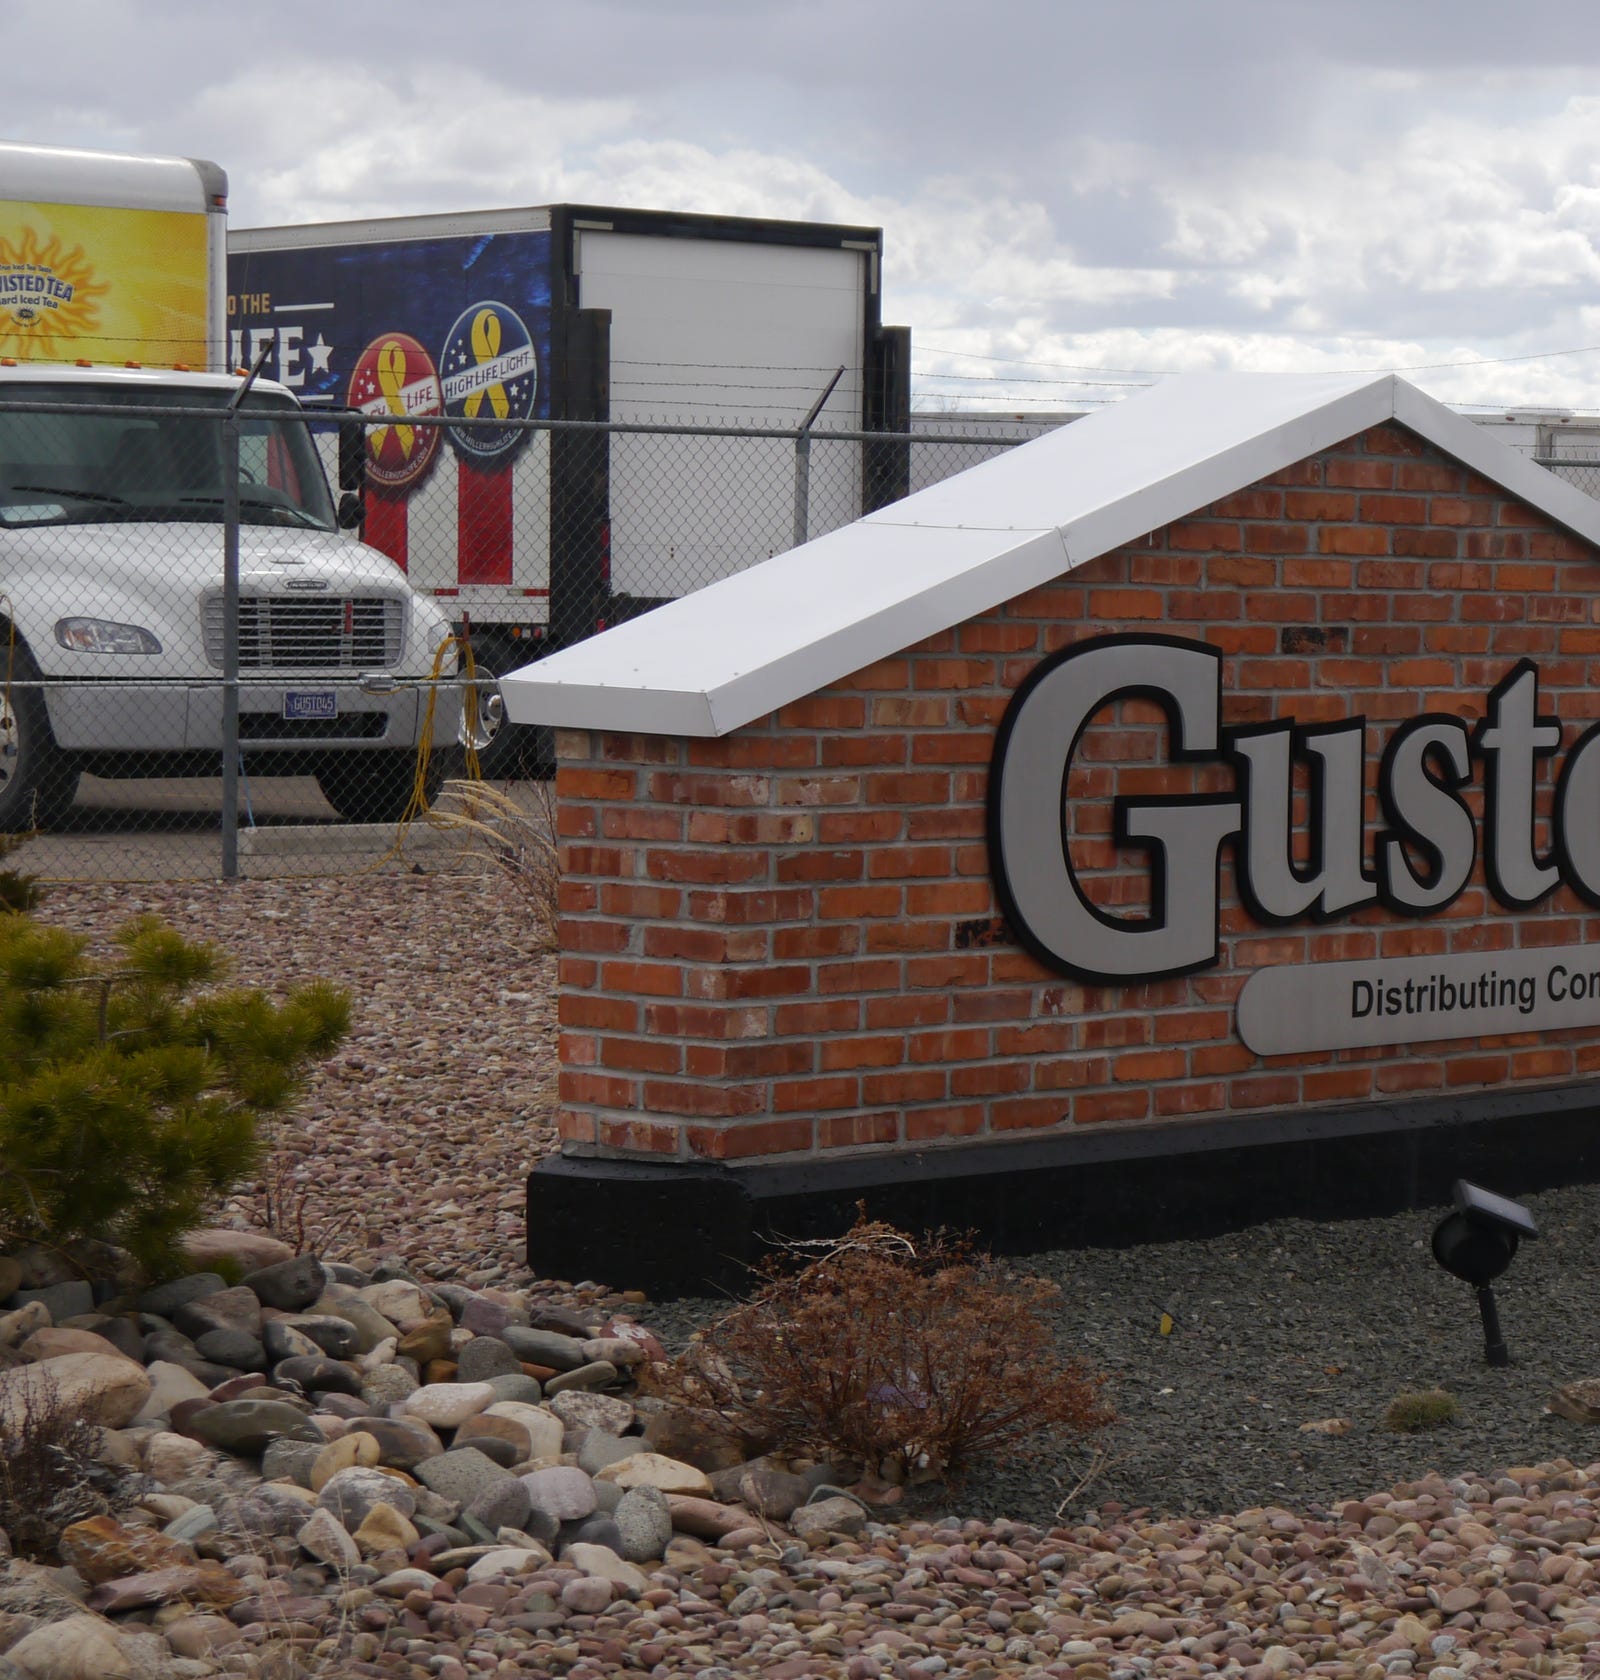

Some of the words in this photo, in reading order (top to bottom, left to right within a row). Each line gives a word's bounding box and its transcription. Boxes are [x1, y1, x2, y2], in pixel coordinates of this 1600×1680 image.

[0, 295, 17, 305] ard
[20, 295, 39, 305] Iced
[42, 296, 58, 309] Tea
[47, 276, 73, 302] TEA
[227, 295, 236, 315] O
[241, 293, 271, 315] THE
[230, 326, 305, 386] IFE
[445, 375, 473, 398] HIGH
[475, 364, 498, 386] LIFE
[500, 351, 529, 375] LIGHT
[407, 385, 432, 410] LIFE
[1351, 970, 1536, 1018] Distributing
